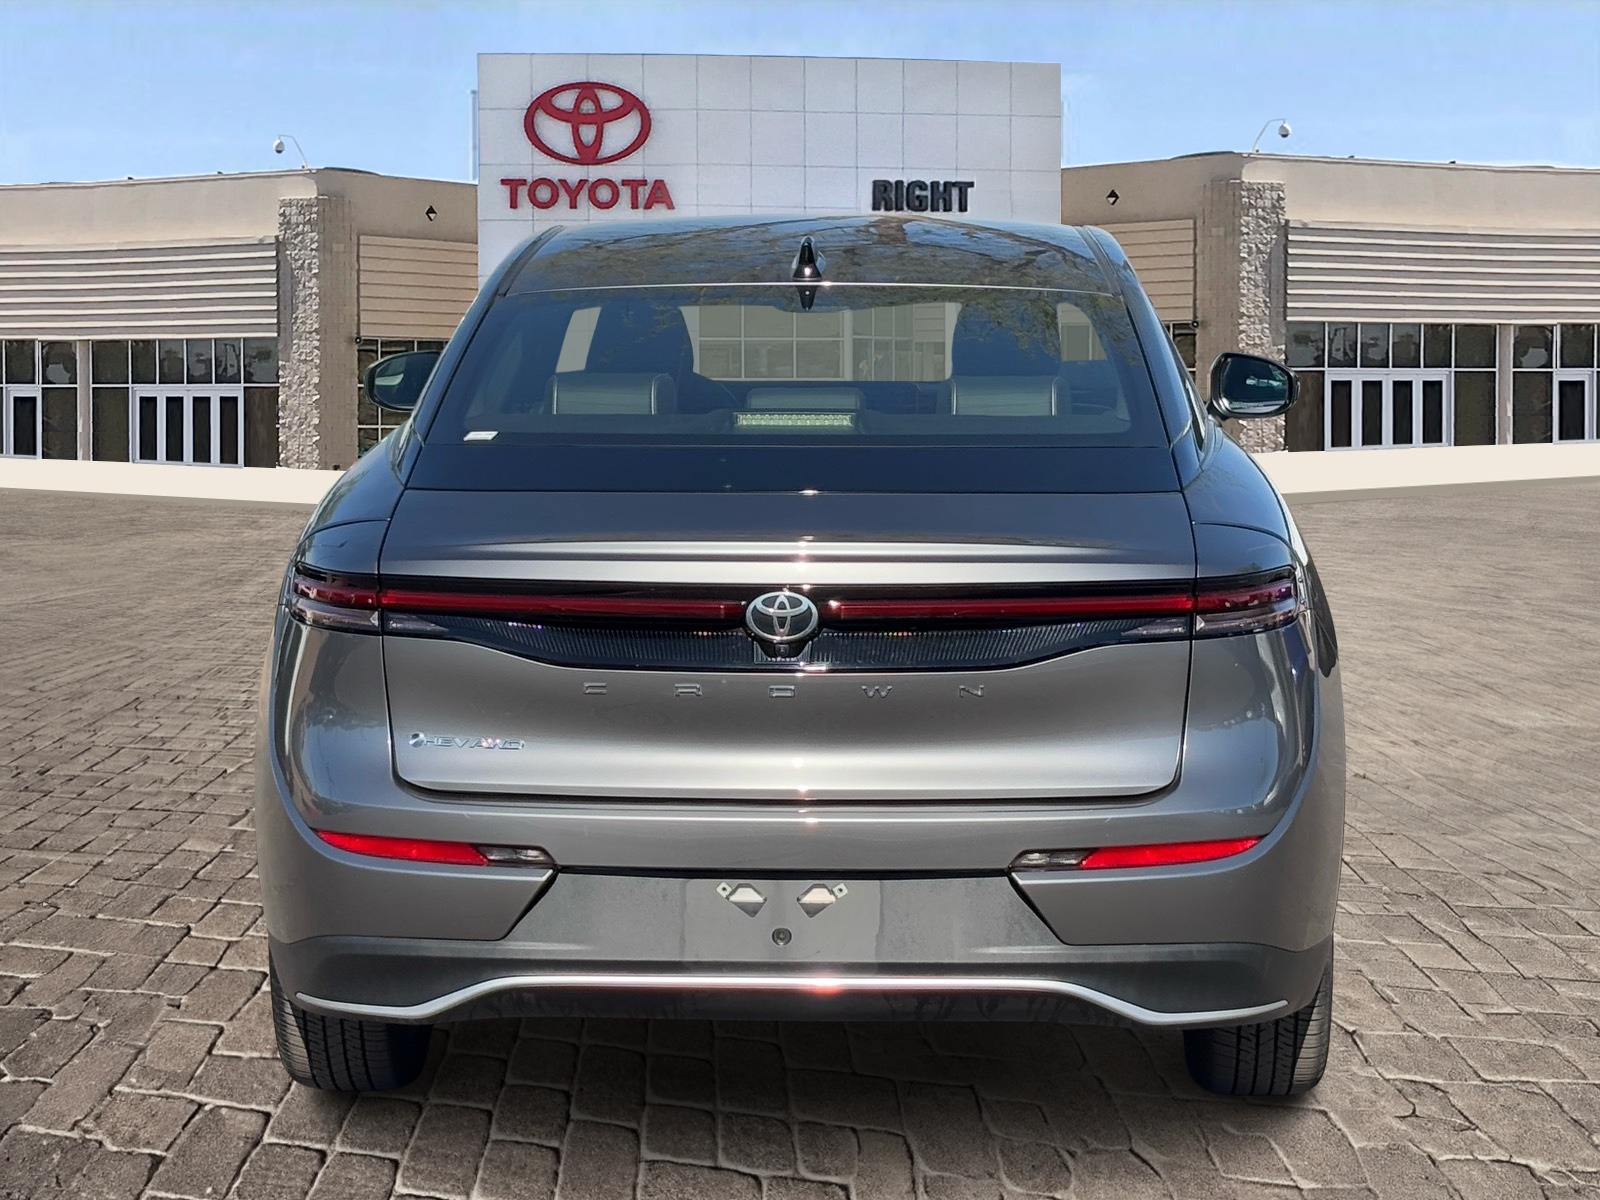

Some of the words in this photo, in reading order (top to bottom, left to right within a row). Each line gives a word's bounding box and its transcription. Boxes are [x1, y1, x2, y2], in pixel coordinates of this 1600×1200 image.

[500, 178, 675, 210] TOYOTA
[871, 179, 975, 212] RIGHT
[582, 682, 985, 698] CROWN
